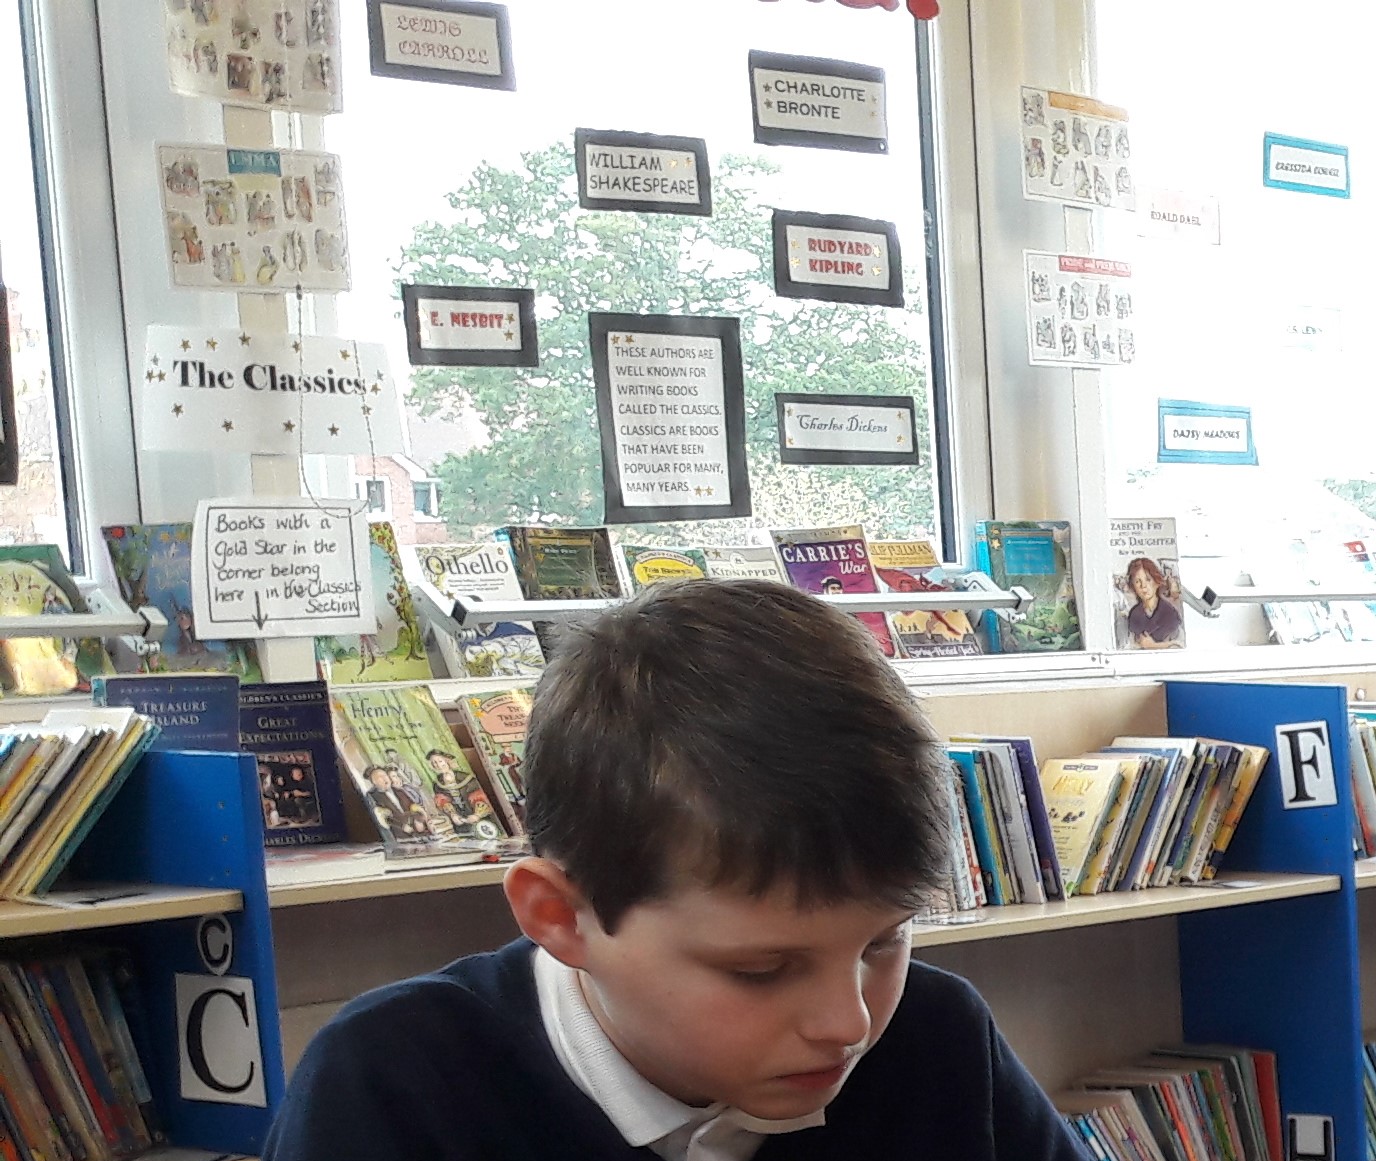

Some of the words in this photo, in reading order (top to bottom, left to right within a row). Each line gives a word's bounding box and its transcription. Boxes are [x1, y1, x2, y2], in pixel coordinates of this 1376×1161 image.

[396, 14, 461, 37] LEWIS
[398, 40, 490, 65] CARROLL
[774, 80, 866, 103] CHARLOTTE
[777, 101, 841, 119] BRONTE
[590, 153, 662, 171] WILLIAM
[590, 175, 695, 196] SHAKESPEARE
[808, 237, 872, 257] RUDYARD
[809, 259, 864, 277] KIPLING
[430, 311, 445, 327] E.
[451, 312, 504, 329] NESBIT
[615, 346, 647, 358] THESE
[651, 348, 696, 359] AUTHORS
[698, 349, 714, 359] ARE
[173, 360, 234, 391] The
[242, 364, 367, 395] Classics
[616, 366, 645, 377] WELL
[648, 366, 688, 377] KNOWN
[689, 367, 707, 377] FOR
[617, 384, 664, 396] WRITING
[666, 386, 699, 396] BOOKS
[618, 403, 657, 415] CALLED
[659, 404, 679, 415] THE
[620, 425, 666, 436] CLASSICS
[669, 425, 687, 436] ARE
[690, 426, 719, 436] BOOKS
[796, 413, 844, 433] Charles
[846, 413, 888, 433] Dickens
[622, 444, 649, 455] THAT
[651, 444, 679, 455] HAVE
[681, 444, 704, 455] BEEN
[624, 463, 671, 474] POPULAR
[673, 463, 692, 473] FOR
[626, 482, 656, 492] MANY
[658, 481, 692, 492] YEARS.
[215, 513, 265, 533] Books
[276, 514, 311, 530] with
[320, 517, 332, 530] a
[293, 540, 306, 555] in
[314, 538, 337, 555] the
[782, 542, 866, 563] CARRIE'S
[217, 566, 265, 581] corner
[271, 563, 320, 584] belong
[425, 552, 509, 577] Othello
[711, 567, 777, 577] KIDNAPPED
[838, 560, 868, 575] War
[214, 586, 245, 602] here
[265, 587, 280, 599] in
[308, 579, 362, 598] Classics
[305, 596, 360, 613] Section
[258, 717, 298, 729] GREAT
[1280, 727, 1326, 803] F
[199, 918, 230, 967] C
[186, 988, 255, 1094] C
